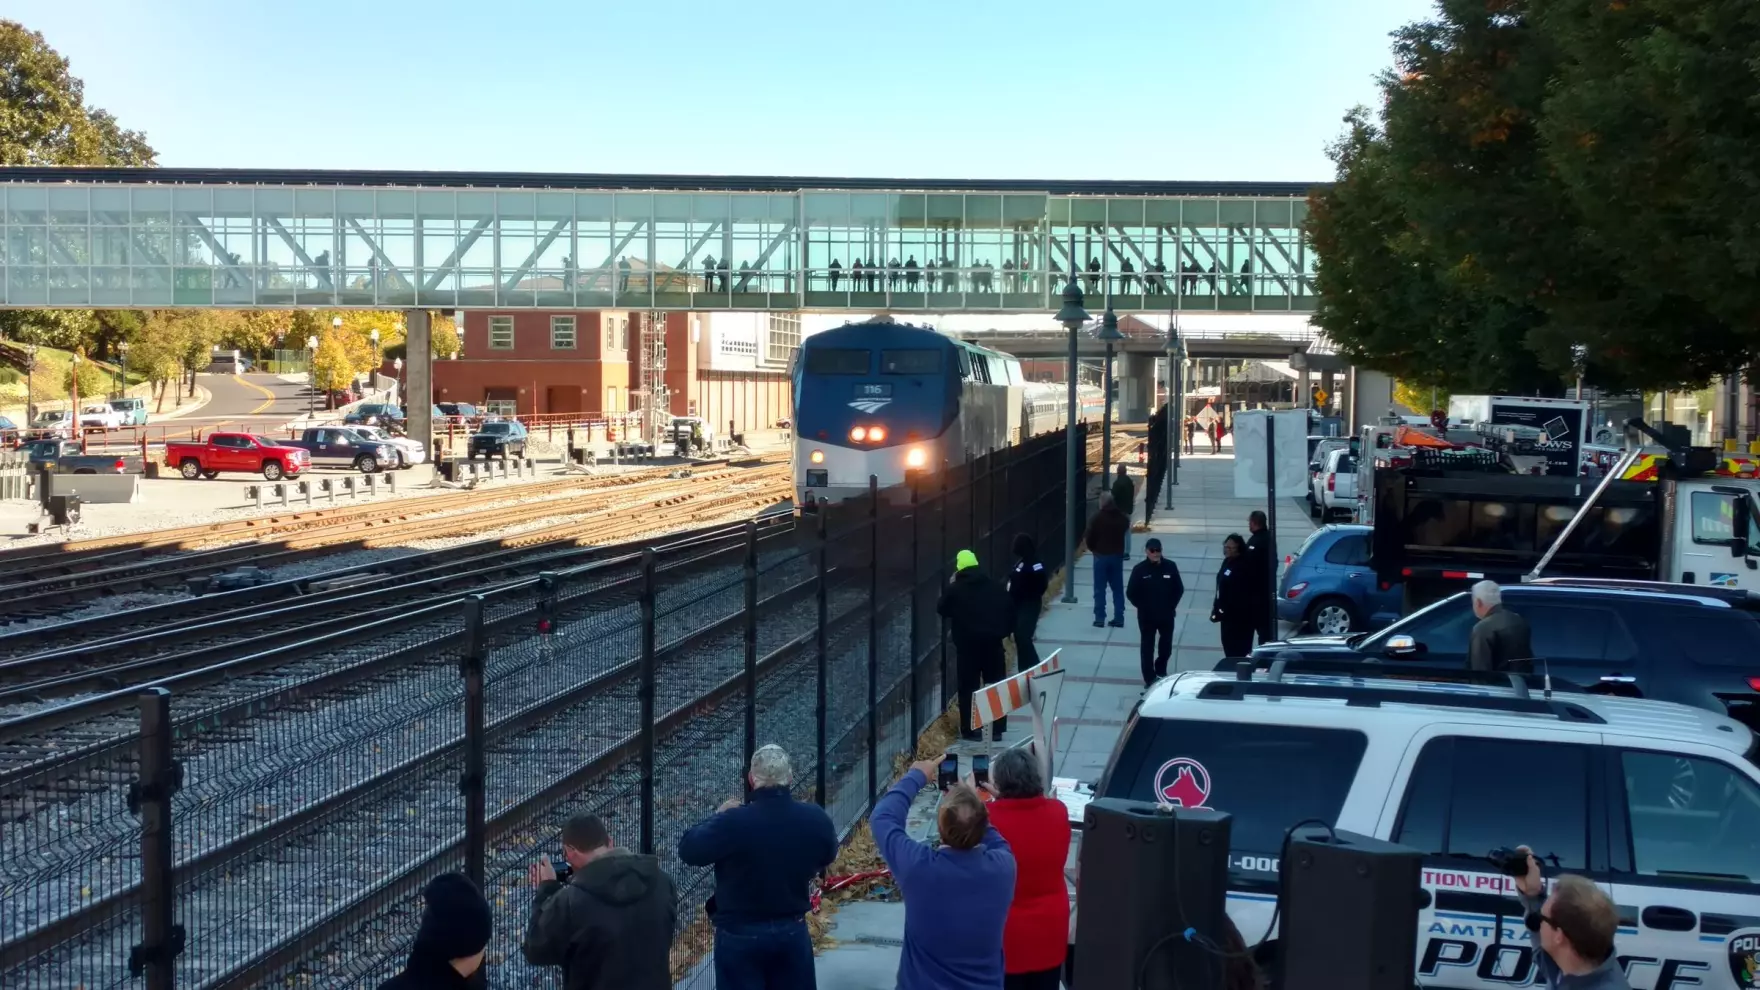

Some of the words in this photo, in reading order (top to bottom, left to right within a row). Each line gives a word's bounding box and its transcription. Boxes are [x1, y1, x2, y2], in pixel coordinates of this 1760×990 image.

[864, 385, 882, 394] 116
[1423, 871, 1470, 888] TION
[1475, 875, 1516, 892] POL
[1427, 922, 1532, 941] AMTRA
[1733, 937, 1760, 954] POL
